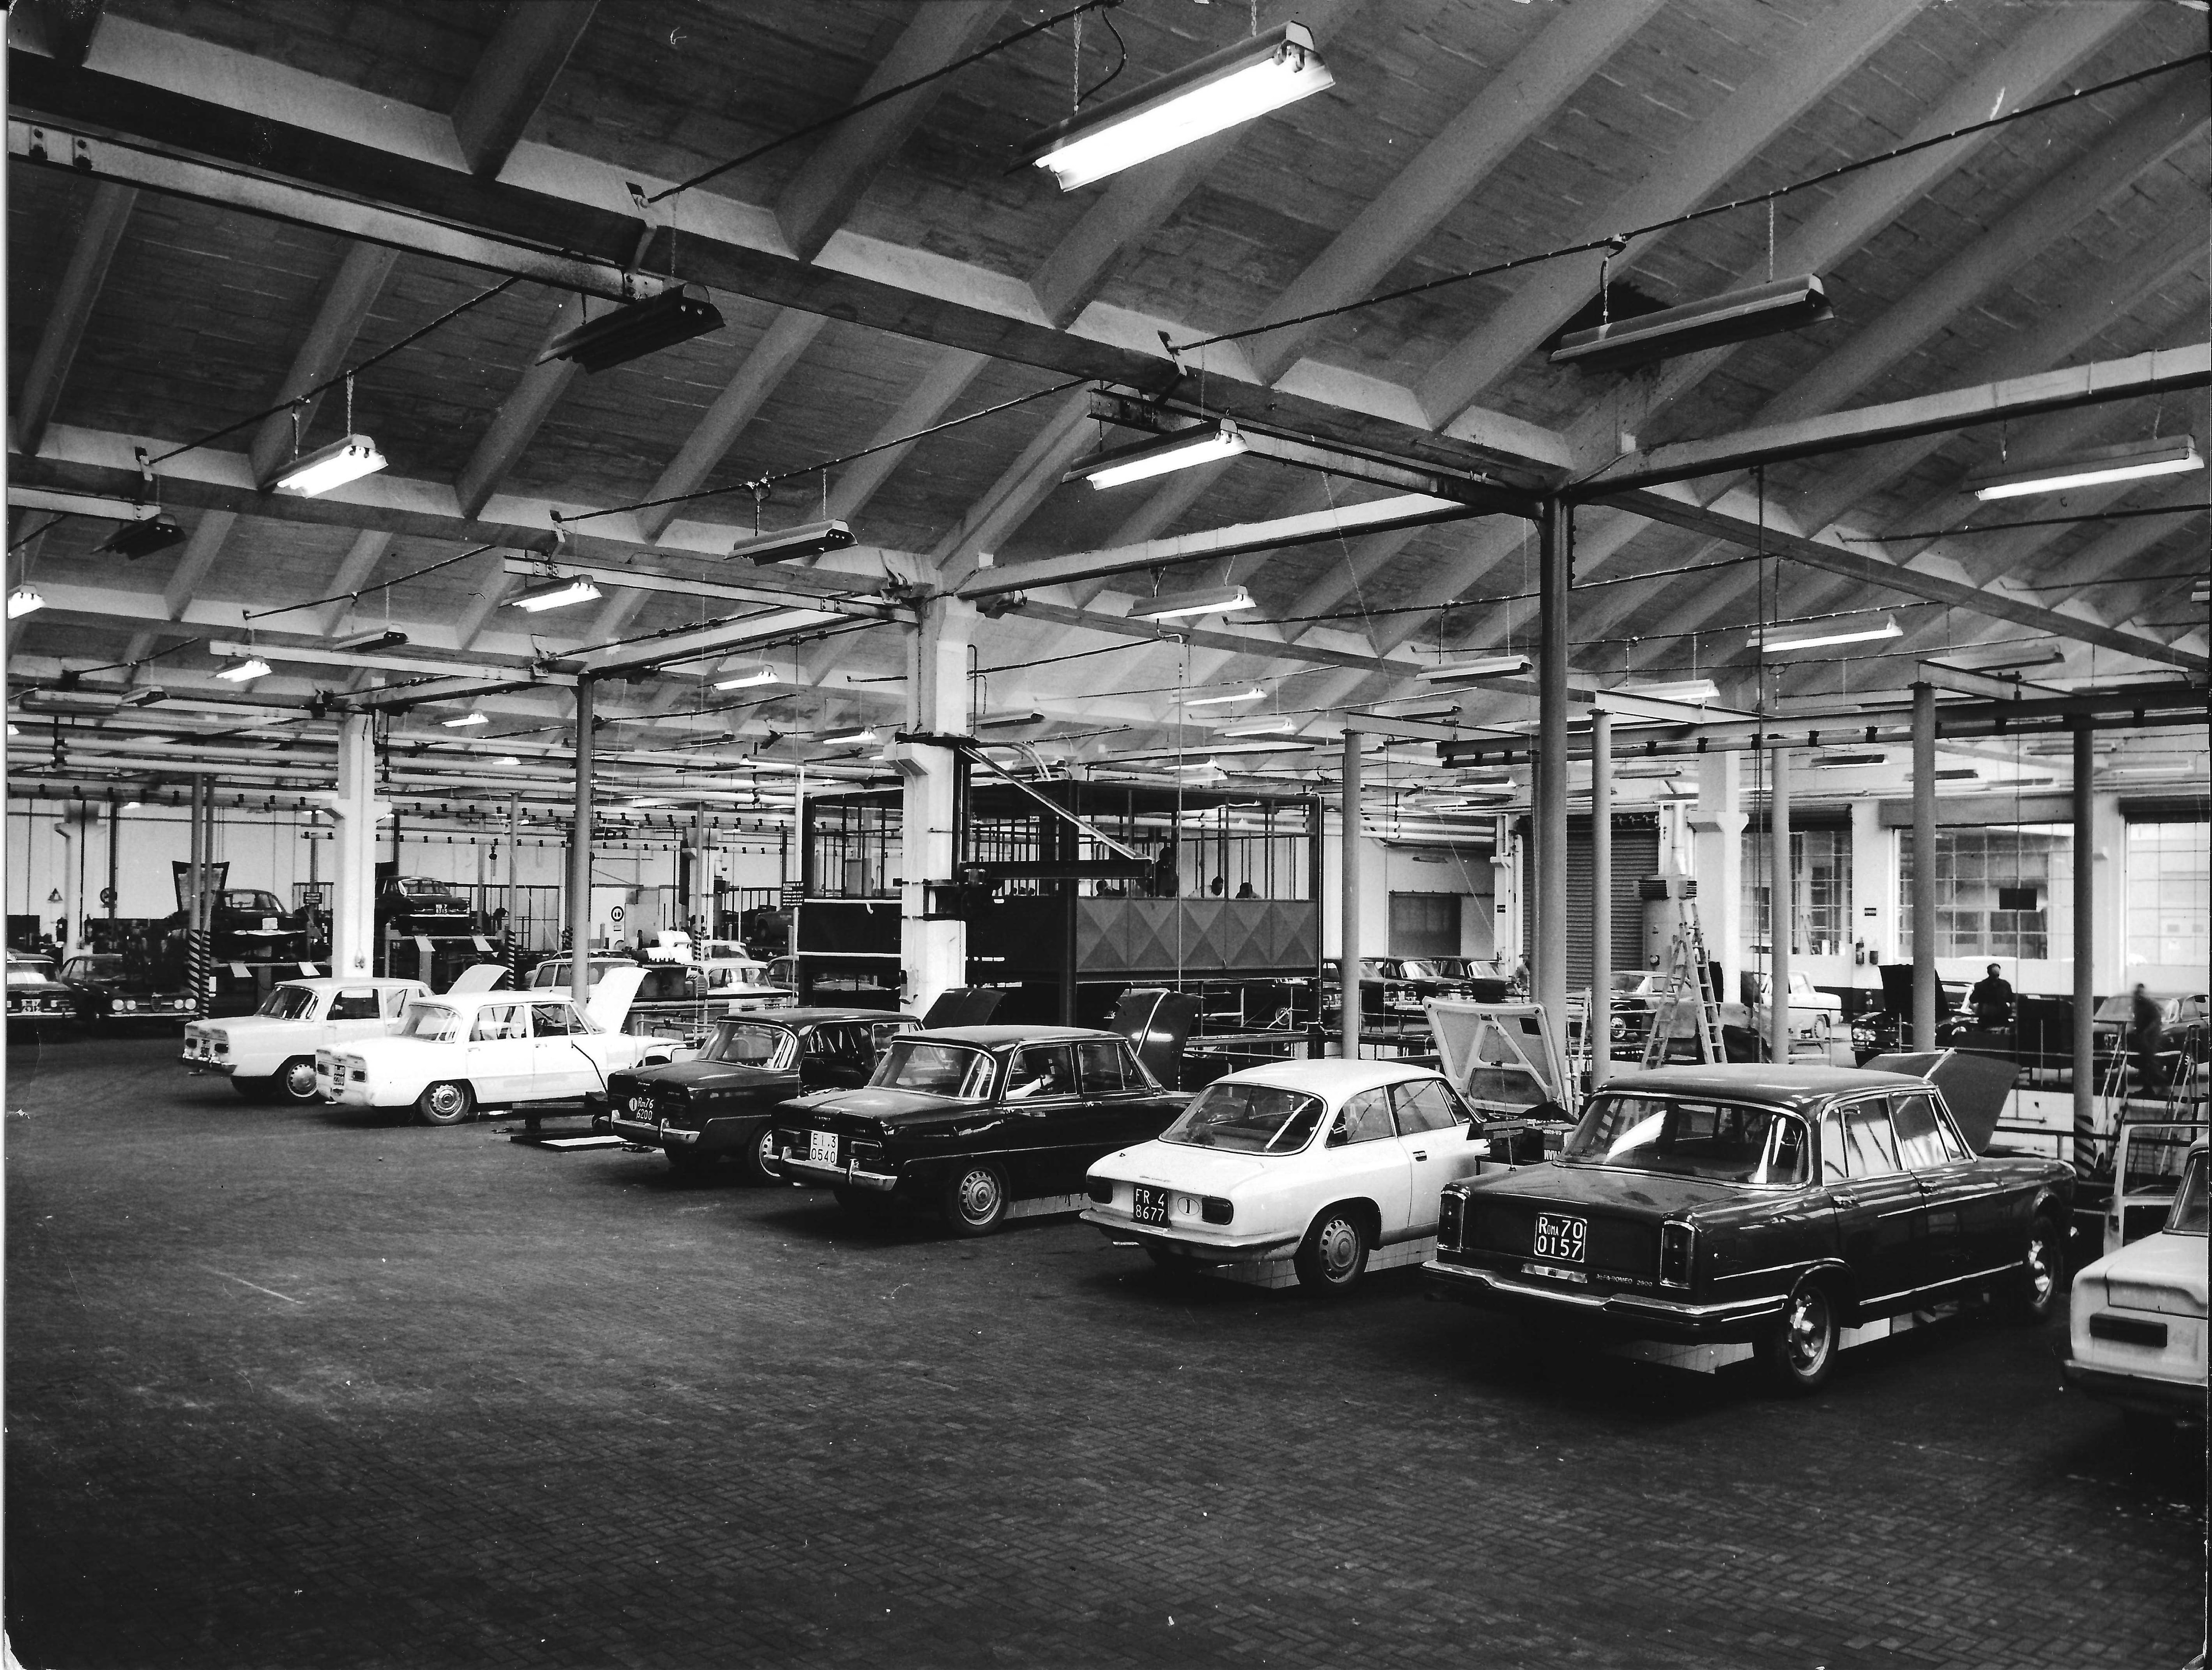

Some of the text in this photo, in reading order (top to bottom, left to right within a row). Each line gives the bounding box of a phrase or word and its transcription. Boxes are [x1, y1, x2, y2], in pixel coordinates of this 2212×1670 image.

[645, 1098, 654, 1109] 76
[637, 1108, 653, 1120] 6200
[811, 1148, 835, 1163] 0540
[1136, 1188, 1164, 1207] FR 4
[1136, 1204, 1164, 1222] 8677
[1186, 1199, 1190, 1214] I
[1561, 1220, 1583, 1239] 70
[1537, 1235, 1582, 1258] 0157
